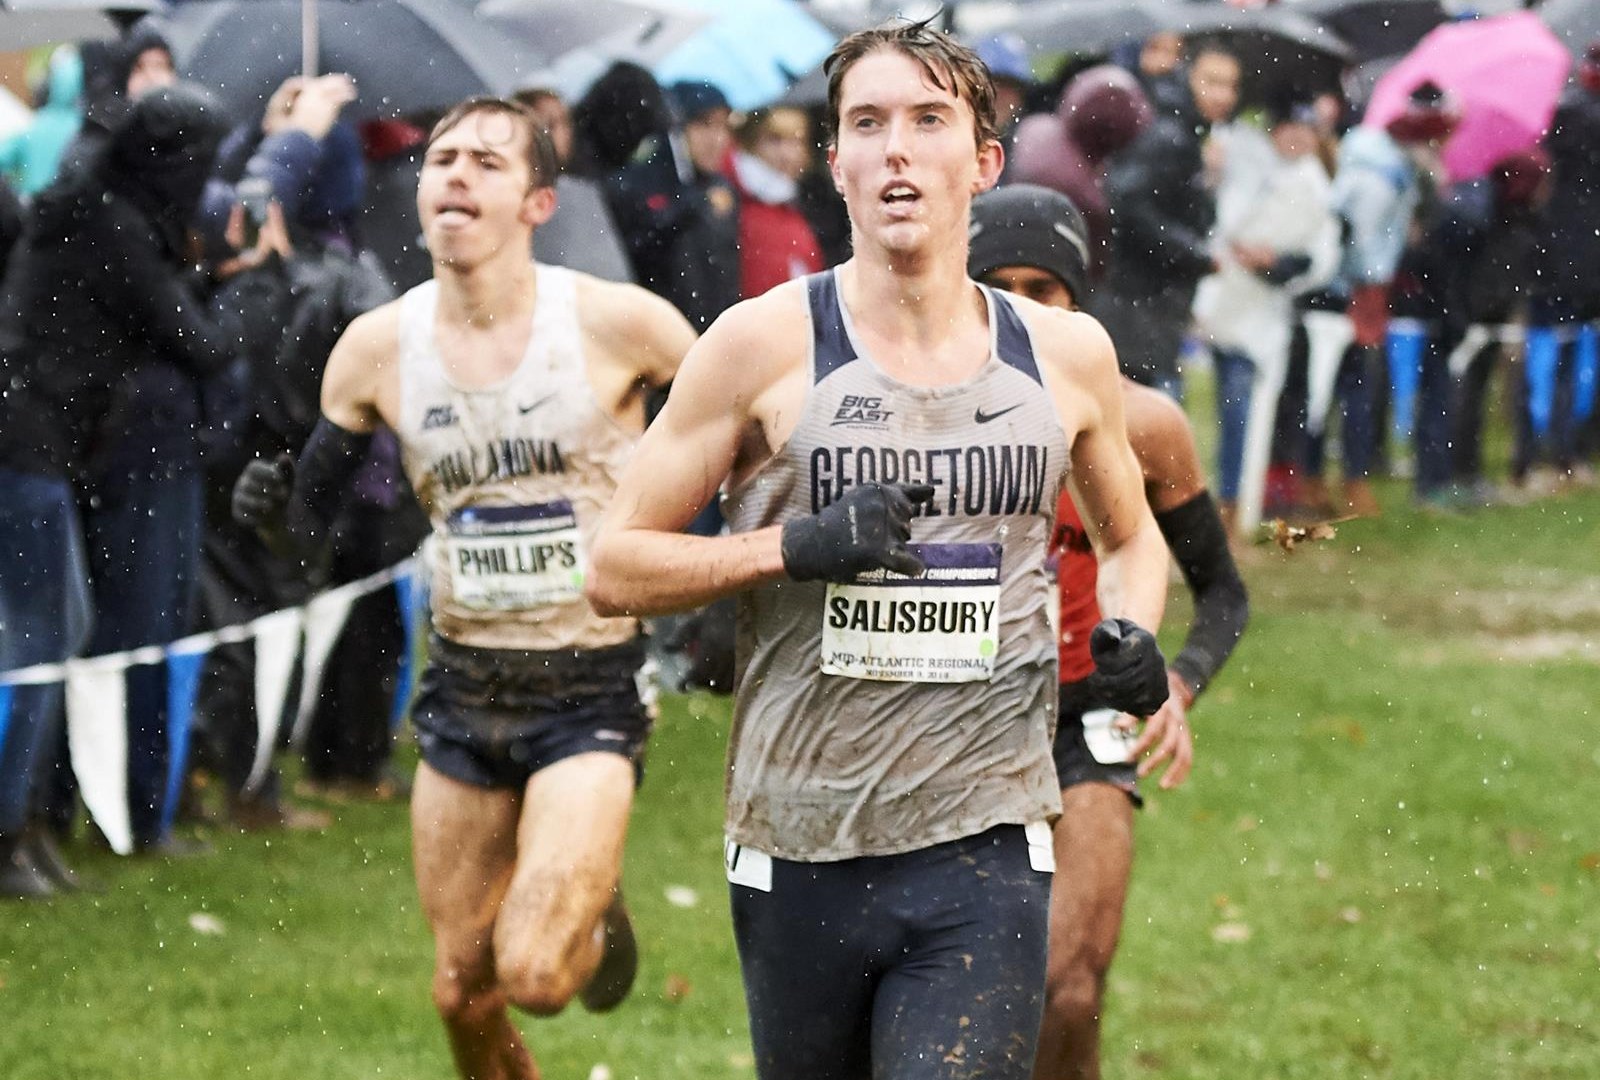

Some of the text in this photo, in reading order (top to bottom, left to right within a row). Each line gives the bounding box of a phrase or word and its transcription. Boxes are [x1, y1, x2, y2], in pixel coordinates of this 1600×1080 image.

[841, 395, 882, 408] BIG
[834, 408, 894, 421] EAST
[457, 540, 577, 575] PHILLIPS
[927, 567, 998, 580] CHAMPIONSHIPS
[828, 596, 995, 634] SALISBURY
[831, 651, 987, 673] MID-ATLANTIC REGIONAL
